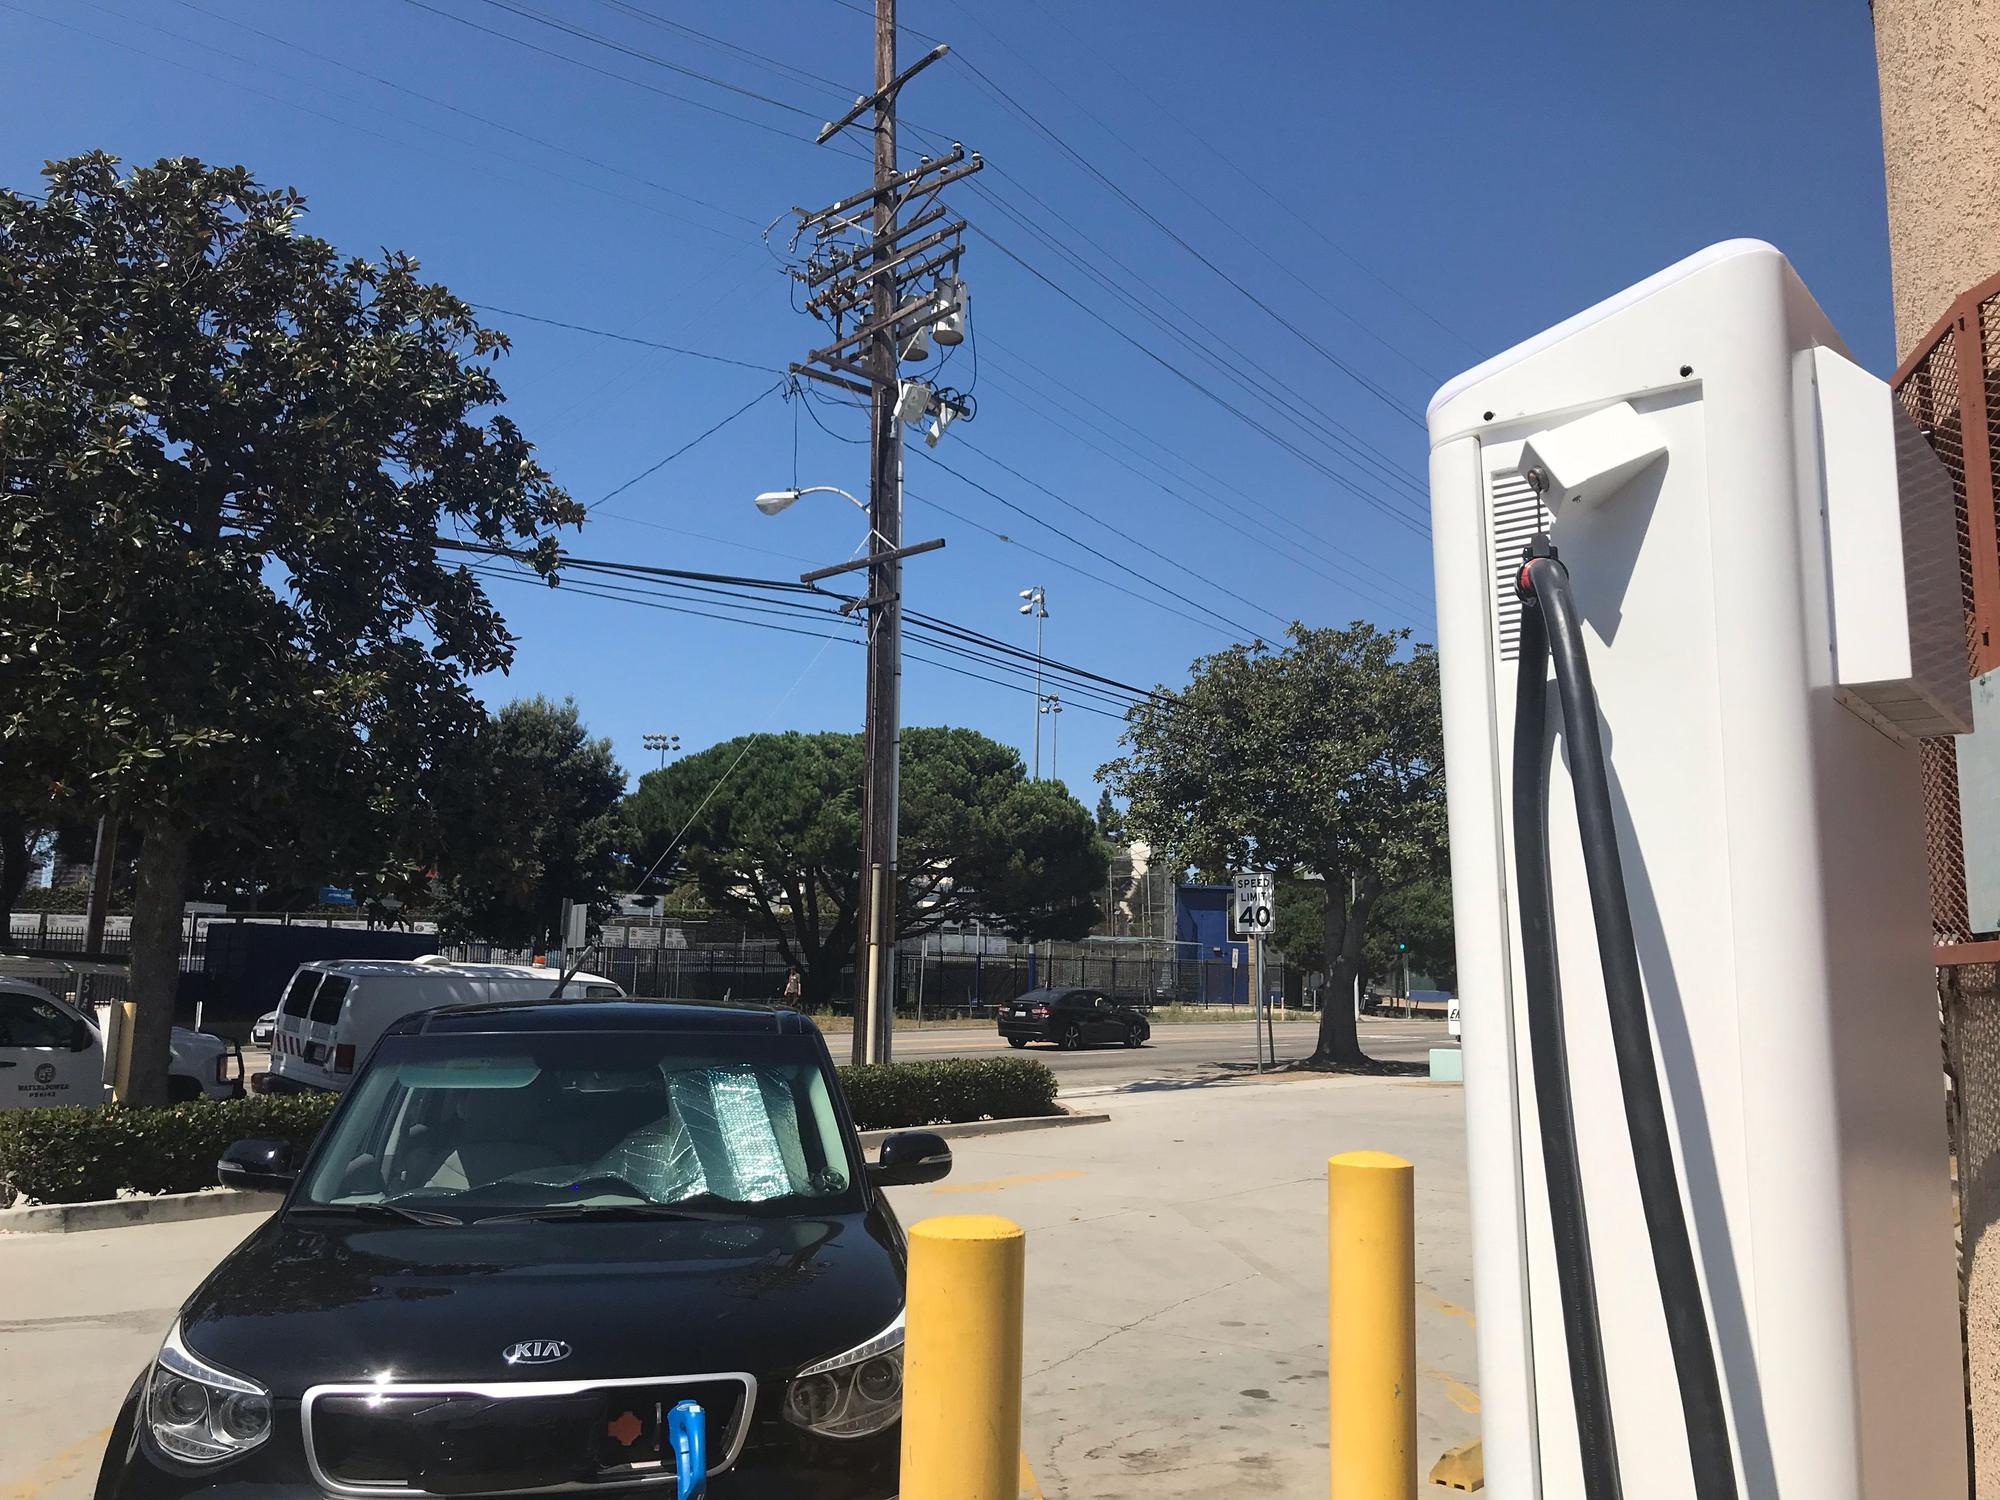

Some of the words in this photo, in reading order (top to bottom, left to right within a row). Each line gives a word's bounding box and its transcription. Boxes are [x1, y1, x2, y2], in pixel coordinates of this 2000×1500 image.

[1237, 879, 1270, 888] SPEED
[1240, 892, 1266, 902] LIMIT
[1239, 906, 1270, 927] 40
[515, 1342, 561, 1357] KIA
